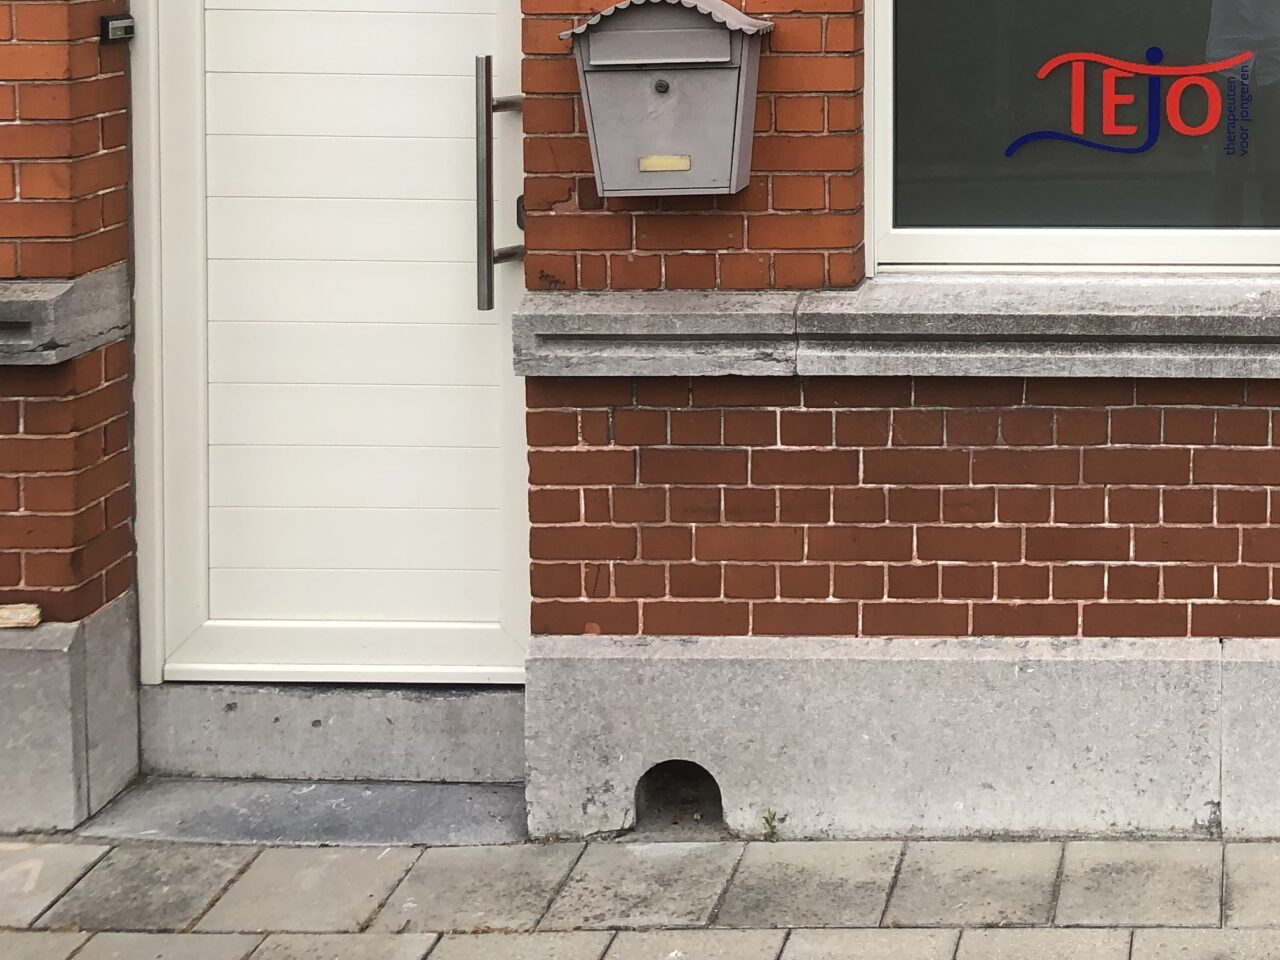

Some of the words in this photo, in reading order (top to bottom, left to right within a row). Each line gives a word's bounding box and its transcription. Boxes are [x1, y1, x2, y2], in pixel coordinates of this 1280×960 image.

[1224, 76, 1239, 156] therapeuten
[1240, 65, 1253, 122] jongeren
[1240, 127, 1249, 156] voor
